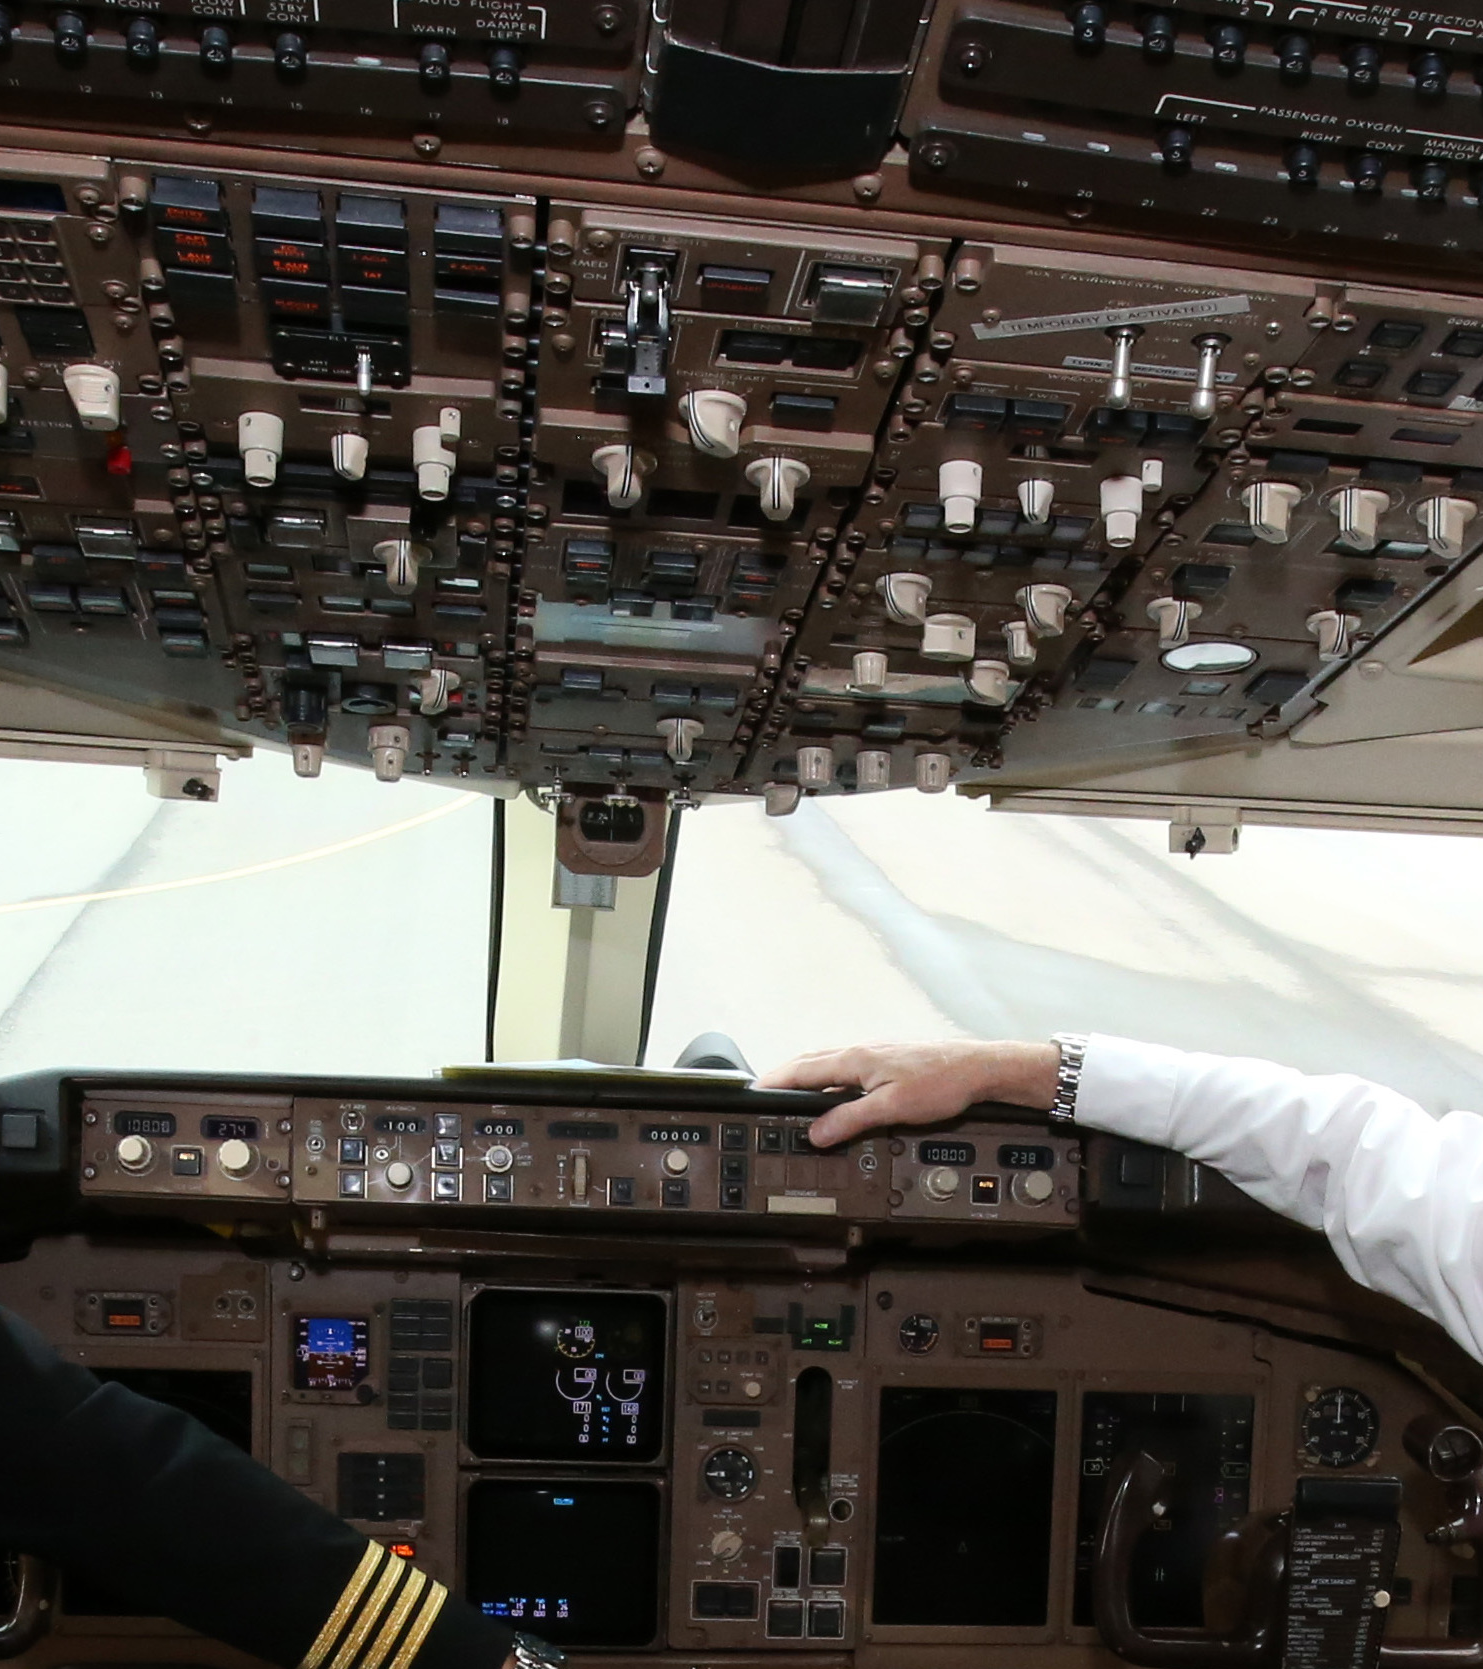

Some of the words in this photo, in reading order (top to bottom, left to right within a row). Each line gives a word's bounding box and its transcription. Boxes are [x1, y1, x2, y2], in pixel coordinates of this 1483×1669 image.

[192, 6, 235, 15] CONT
[270, 3, 303, 12] STBY
[1371, 5, 1400, 17] FIRE
[266, 12, 309, 22] CONT
[491, 10, 523, 21] YAW
[1335, 10, 1391, 26] ENGINE
[411, 24, 457, 36] WARN
[476, 19, 537, 32] DAMPER
[489, 30, 523, 40] LEFT
[1175, 113, 1207, 124] LEFT
[1259, 106, 1338, 125] PASSENGER
[1345, 118, 1404, 134] OXYGEN
[1300, 131, 1342, 143] RIGHT
[1366, 140, 1405, 152] CONT
[1424, 139, 1483, 154] MANUAL
[1423, 149, 1474, 161] DEPLOY
[583, 272, 607, 281] ON
[1008, 313, 1101, 333] TEMPORARY
[1447, 317, 1476, 329] DOOR
[218, 1123, 246, 1136] 274
[484, 1124, 514, 1135] 000
[650, 1131, 700, 1141] 00000
[1010, 1151, 1037, 1164] 238
